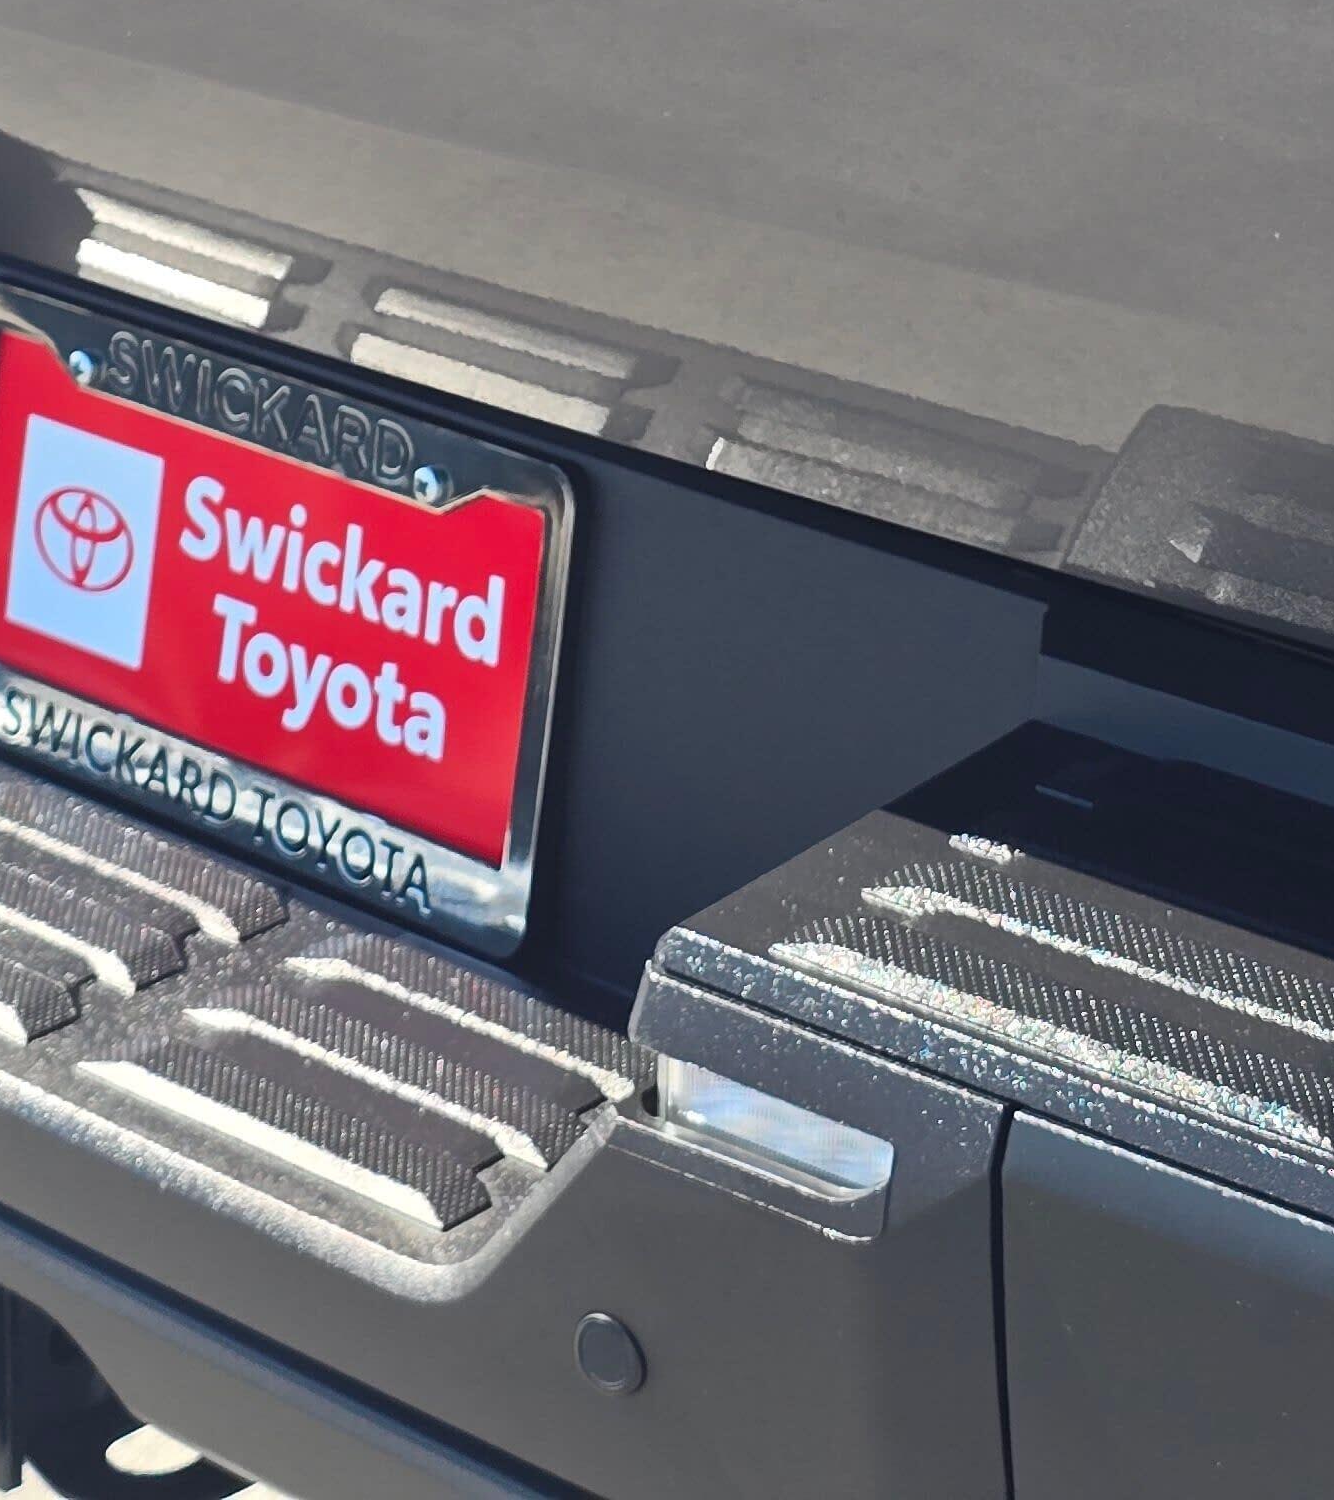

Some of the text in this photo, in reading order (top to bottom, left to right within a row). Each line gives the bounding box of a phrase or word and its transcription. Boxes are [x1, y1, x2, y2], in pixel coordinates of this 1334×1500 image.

[109, 331, 416, 481] SWICKARD
[178, 475, 506, 667] Swickard
[212, 595, 448, 762] Toyota
[1, 686, 433, 912] SWICKARD TOYOTA
